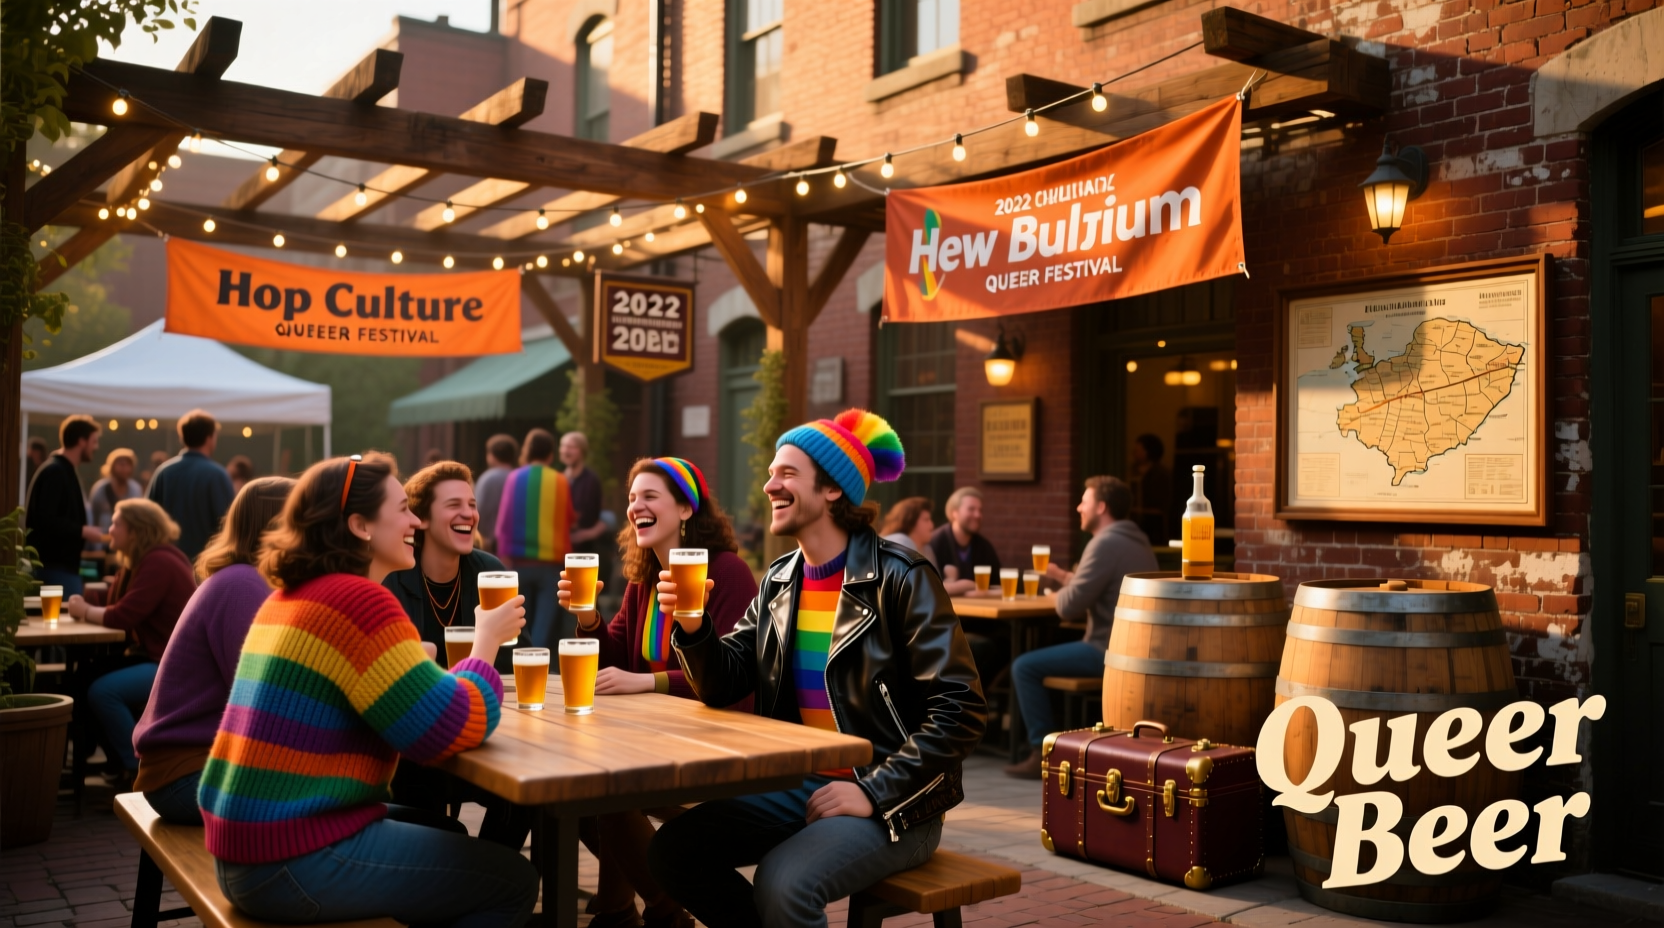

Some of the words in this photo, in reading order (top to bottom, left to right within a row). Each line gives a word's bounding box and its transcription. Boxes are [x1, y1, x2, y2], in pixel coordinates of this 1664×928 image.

[994, 193, 1032, 216] 2022
[985, 269, 1040, 293] QUEER
[1044, 255, 1122, 283] FESTIVAL
[216, 269, 312, 322] Hop
[324, 282, 484, 323] Culture
[612, 290, 681, 319] 2022
[358, 327, 440, 344] FESTIVAL
